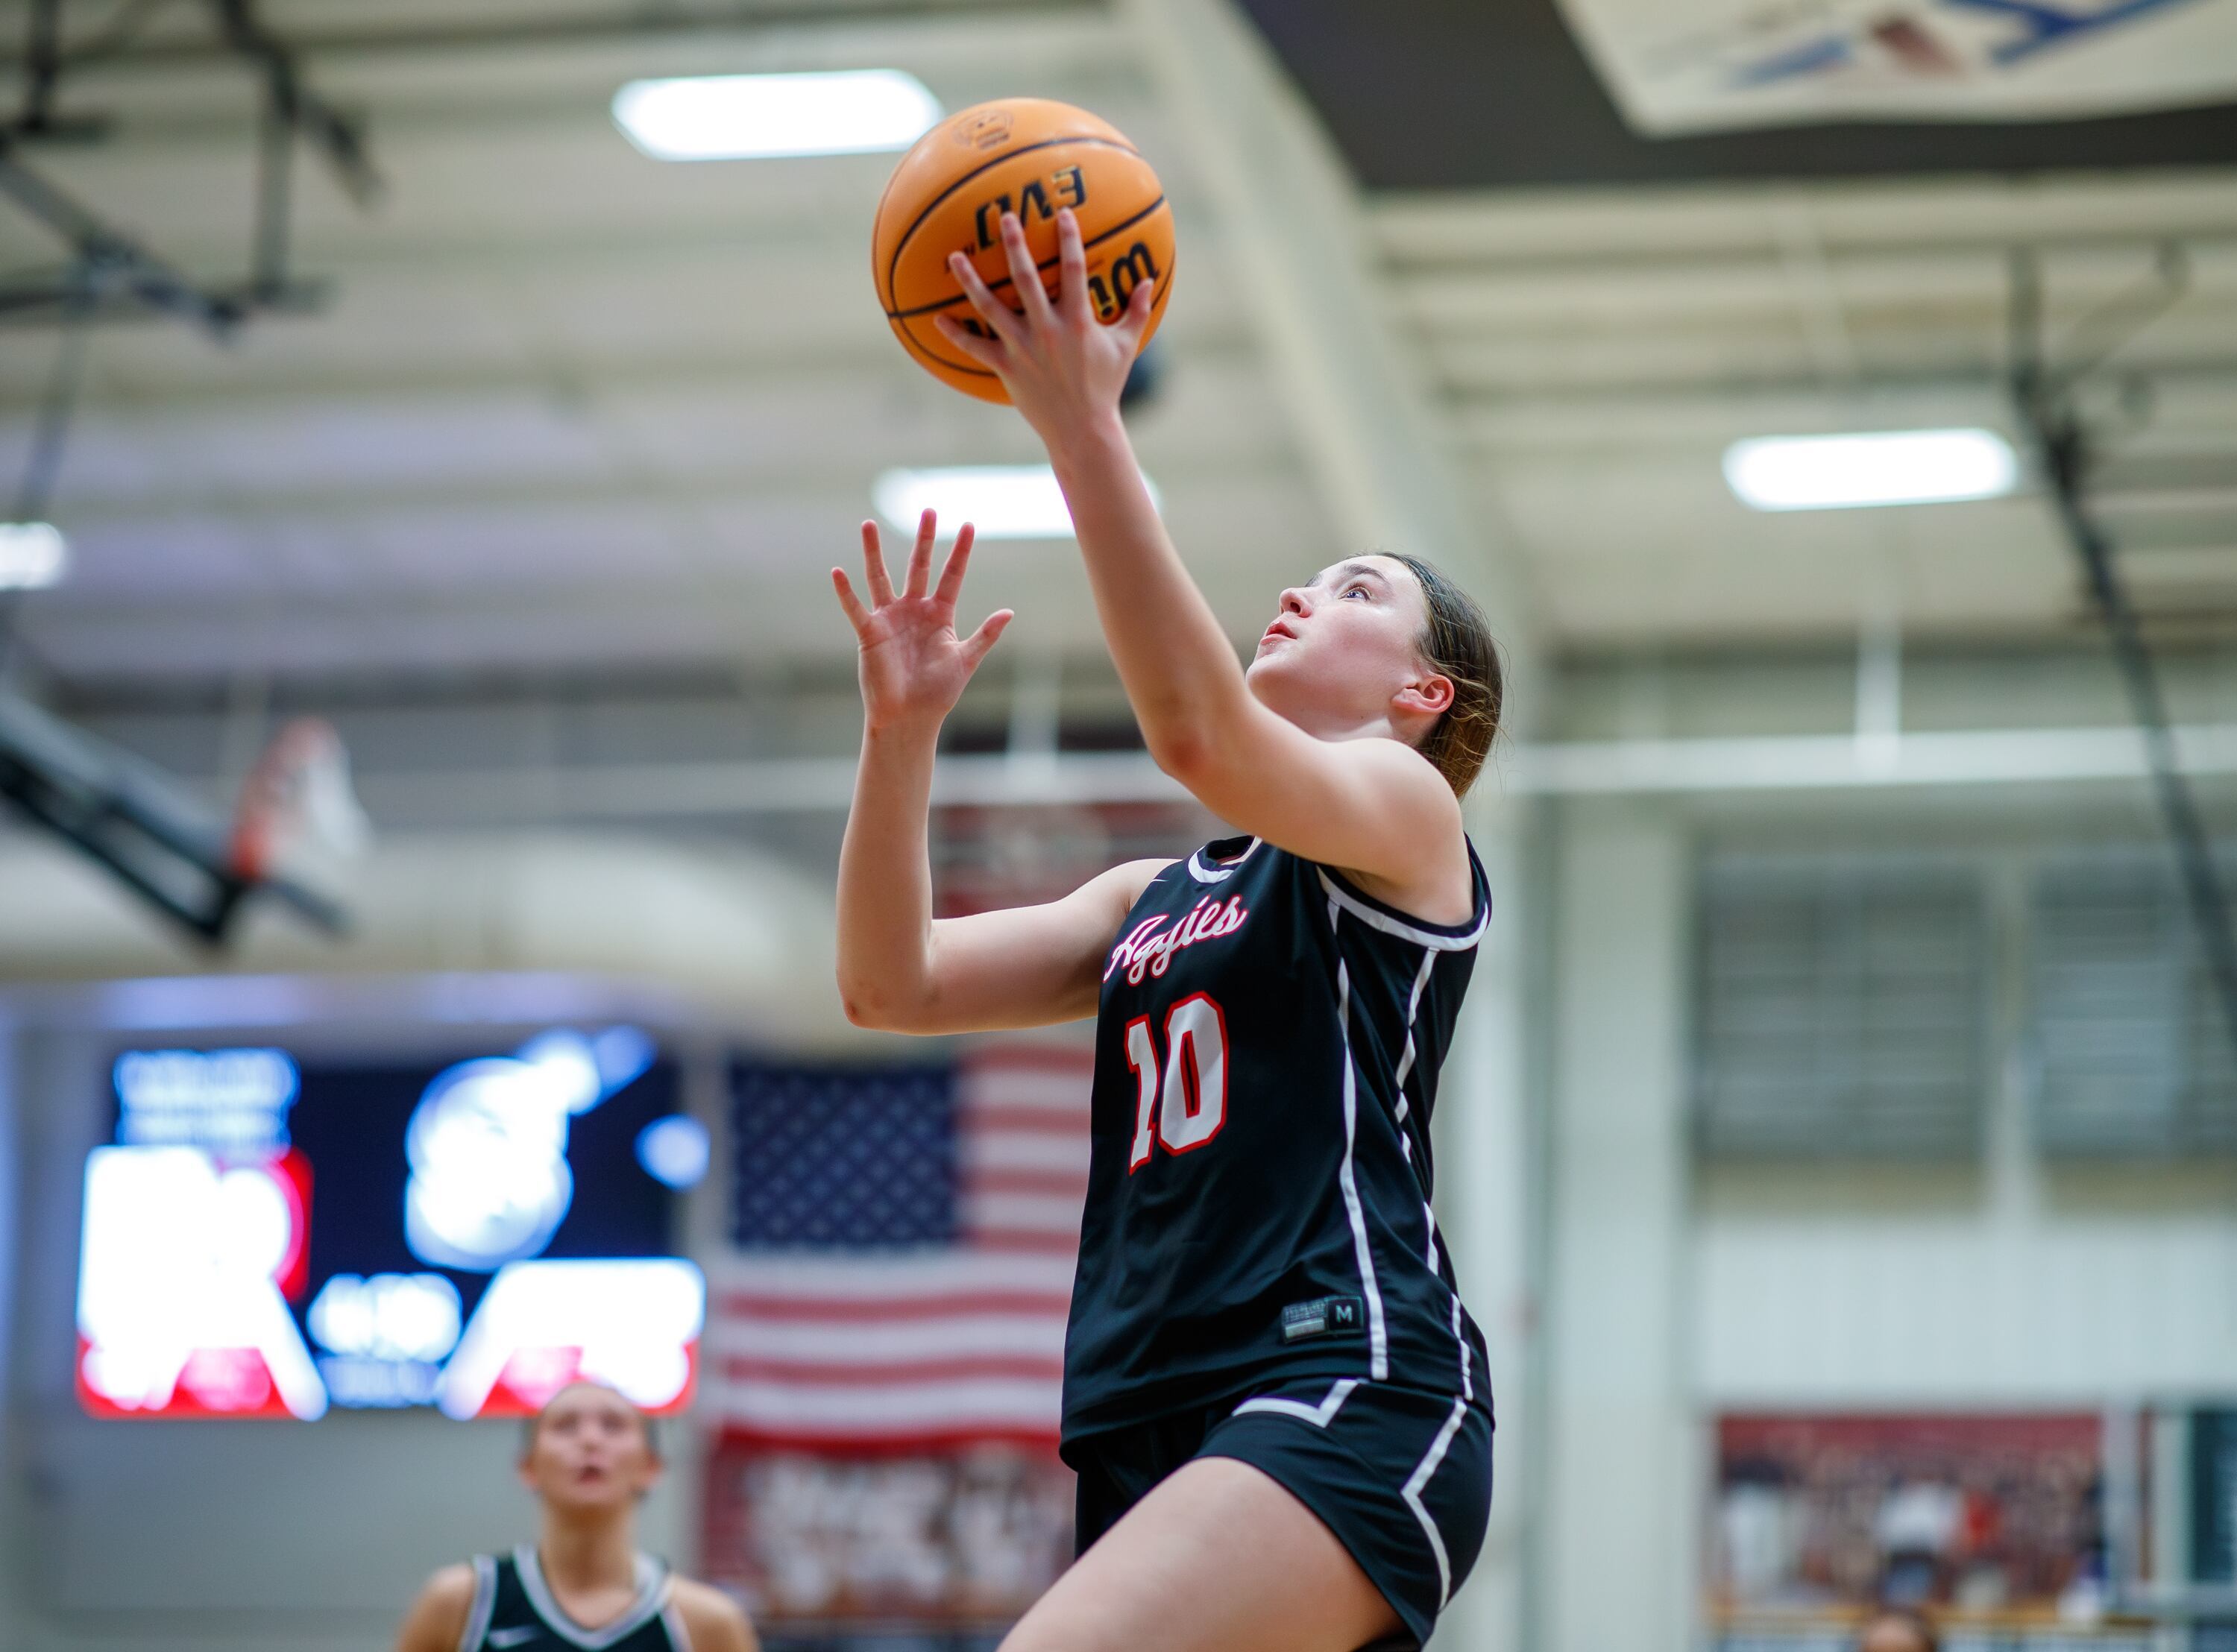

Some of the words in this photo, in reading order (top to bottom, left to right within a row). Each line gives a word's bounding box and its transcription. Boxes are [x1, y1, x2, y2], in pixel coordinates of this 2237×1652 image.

[1103, 894, 1249, 987] Aggies
[1124, 991, 1229, 1176] 10
[1335, 1305, 1353, 1323] M
